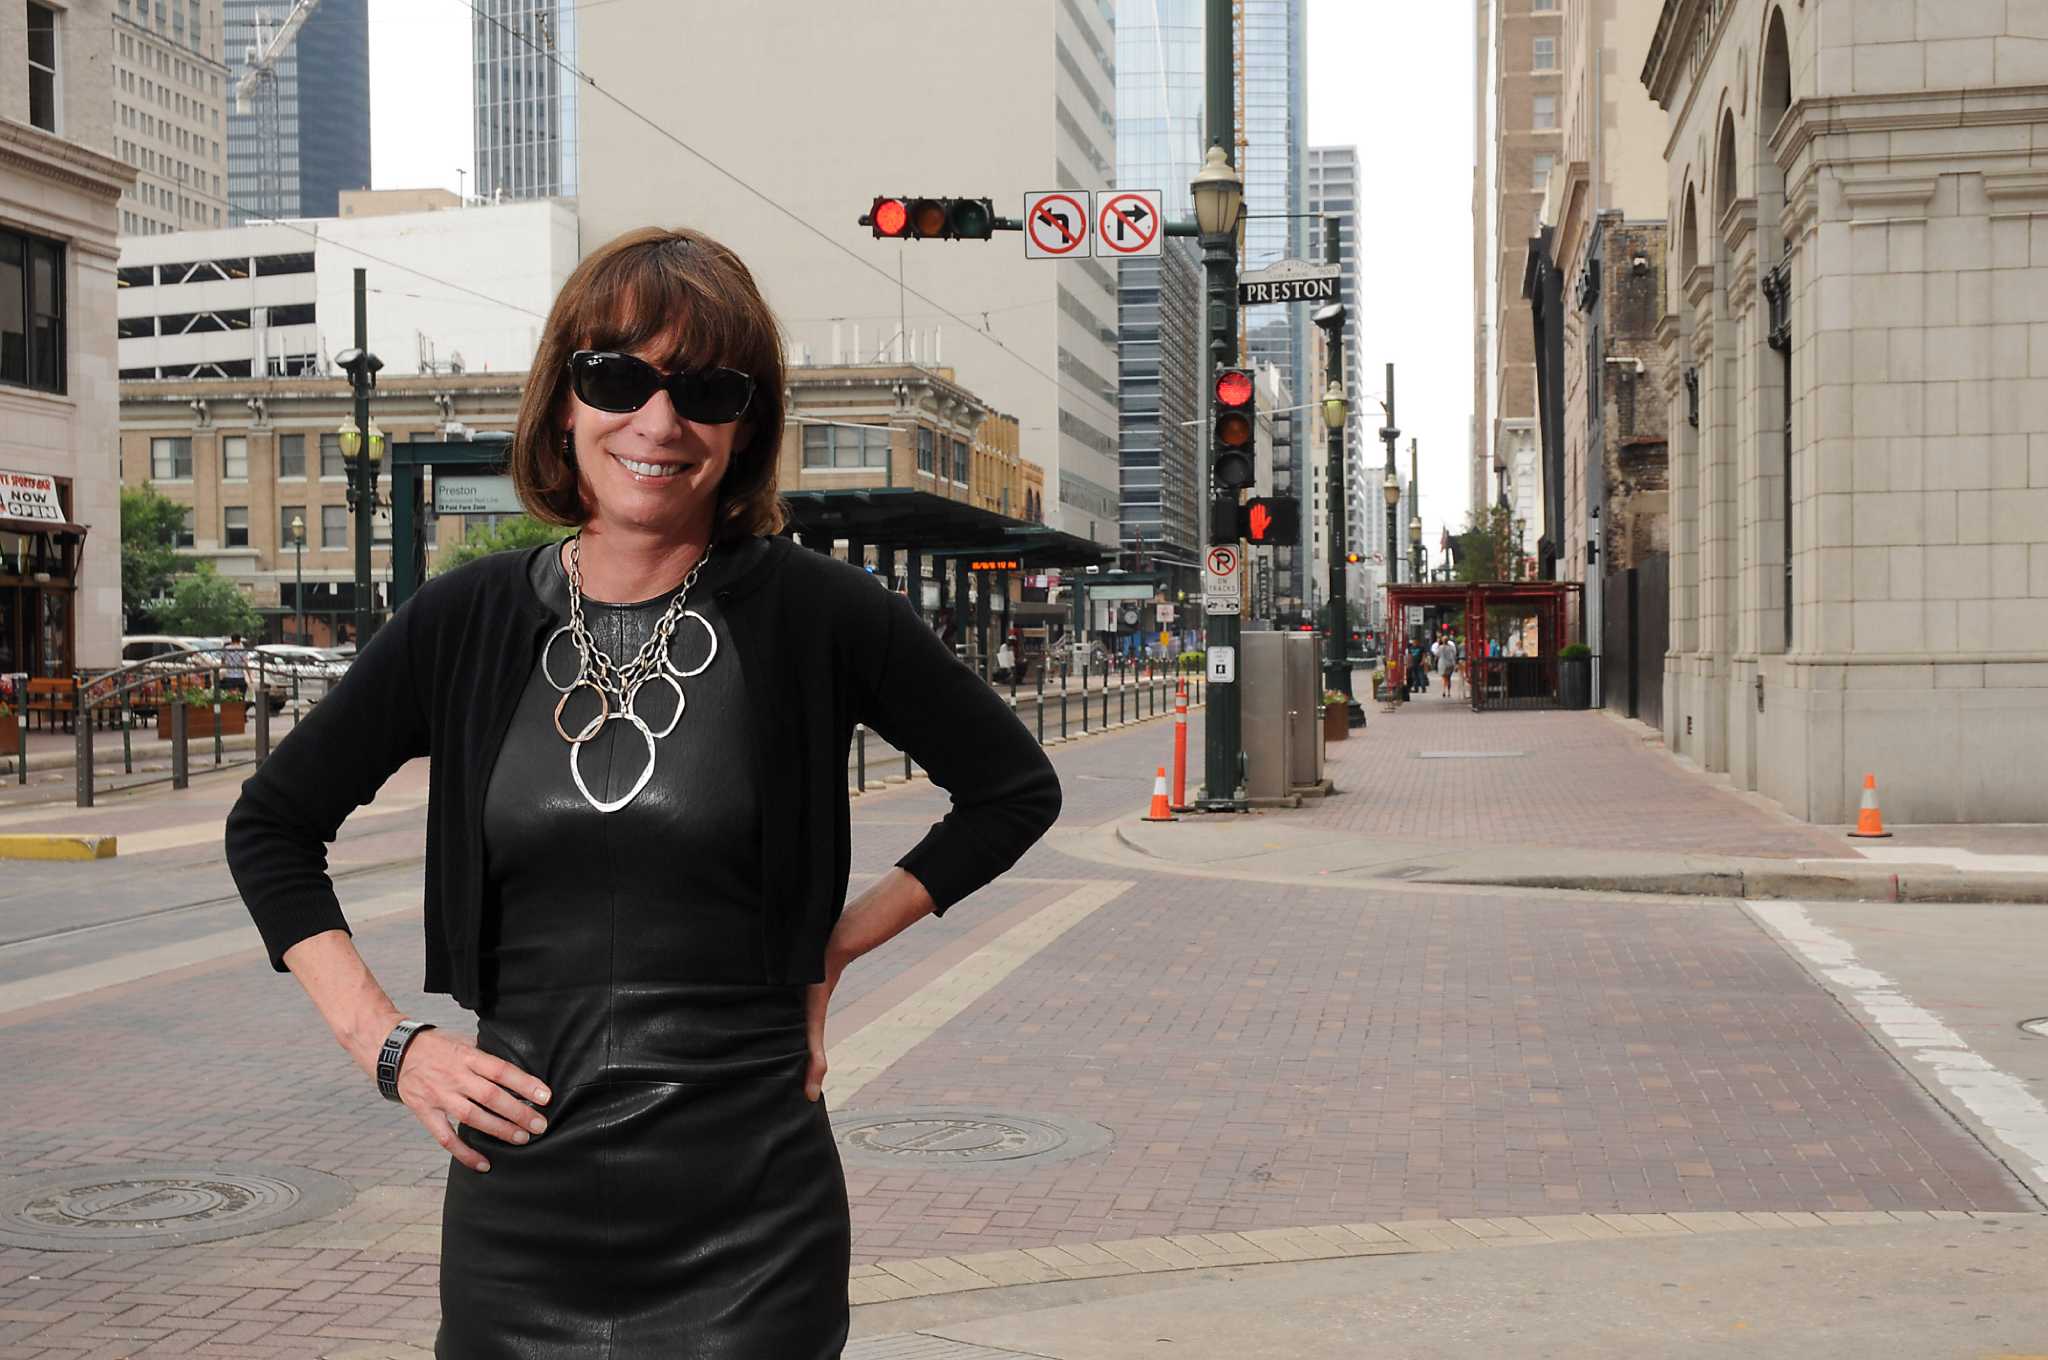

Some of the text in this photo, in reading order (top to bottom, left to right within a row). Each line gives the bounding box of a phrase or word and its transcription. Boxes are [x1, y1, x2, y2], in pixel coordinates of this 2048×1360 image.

[1247, 280, 1333, 301] PRESTON
[11, 490, 47, 503] NOW
[439, 485, 477, 496] Preston
[8, 502, 58, 519] OPEN
